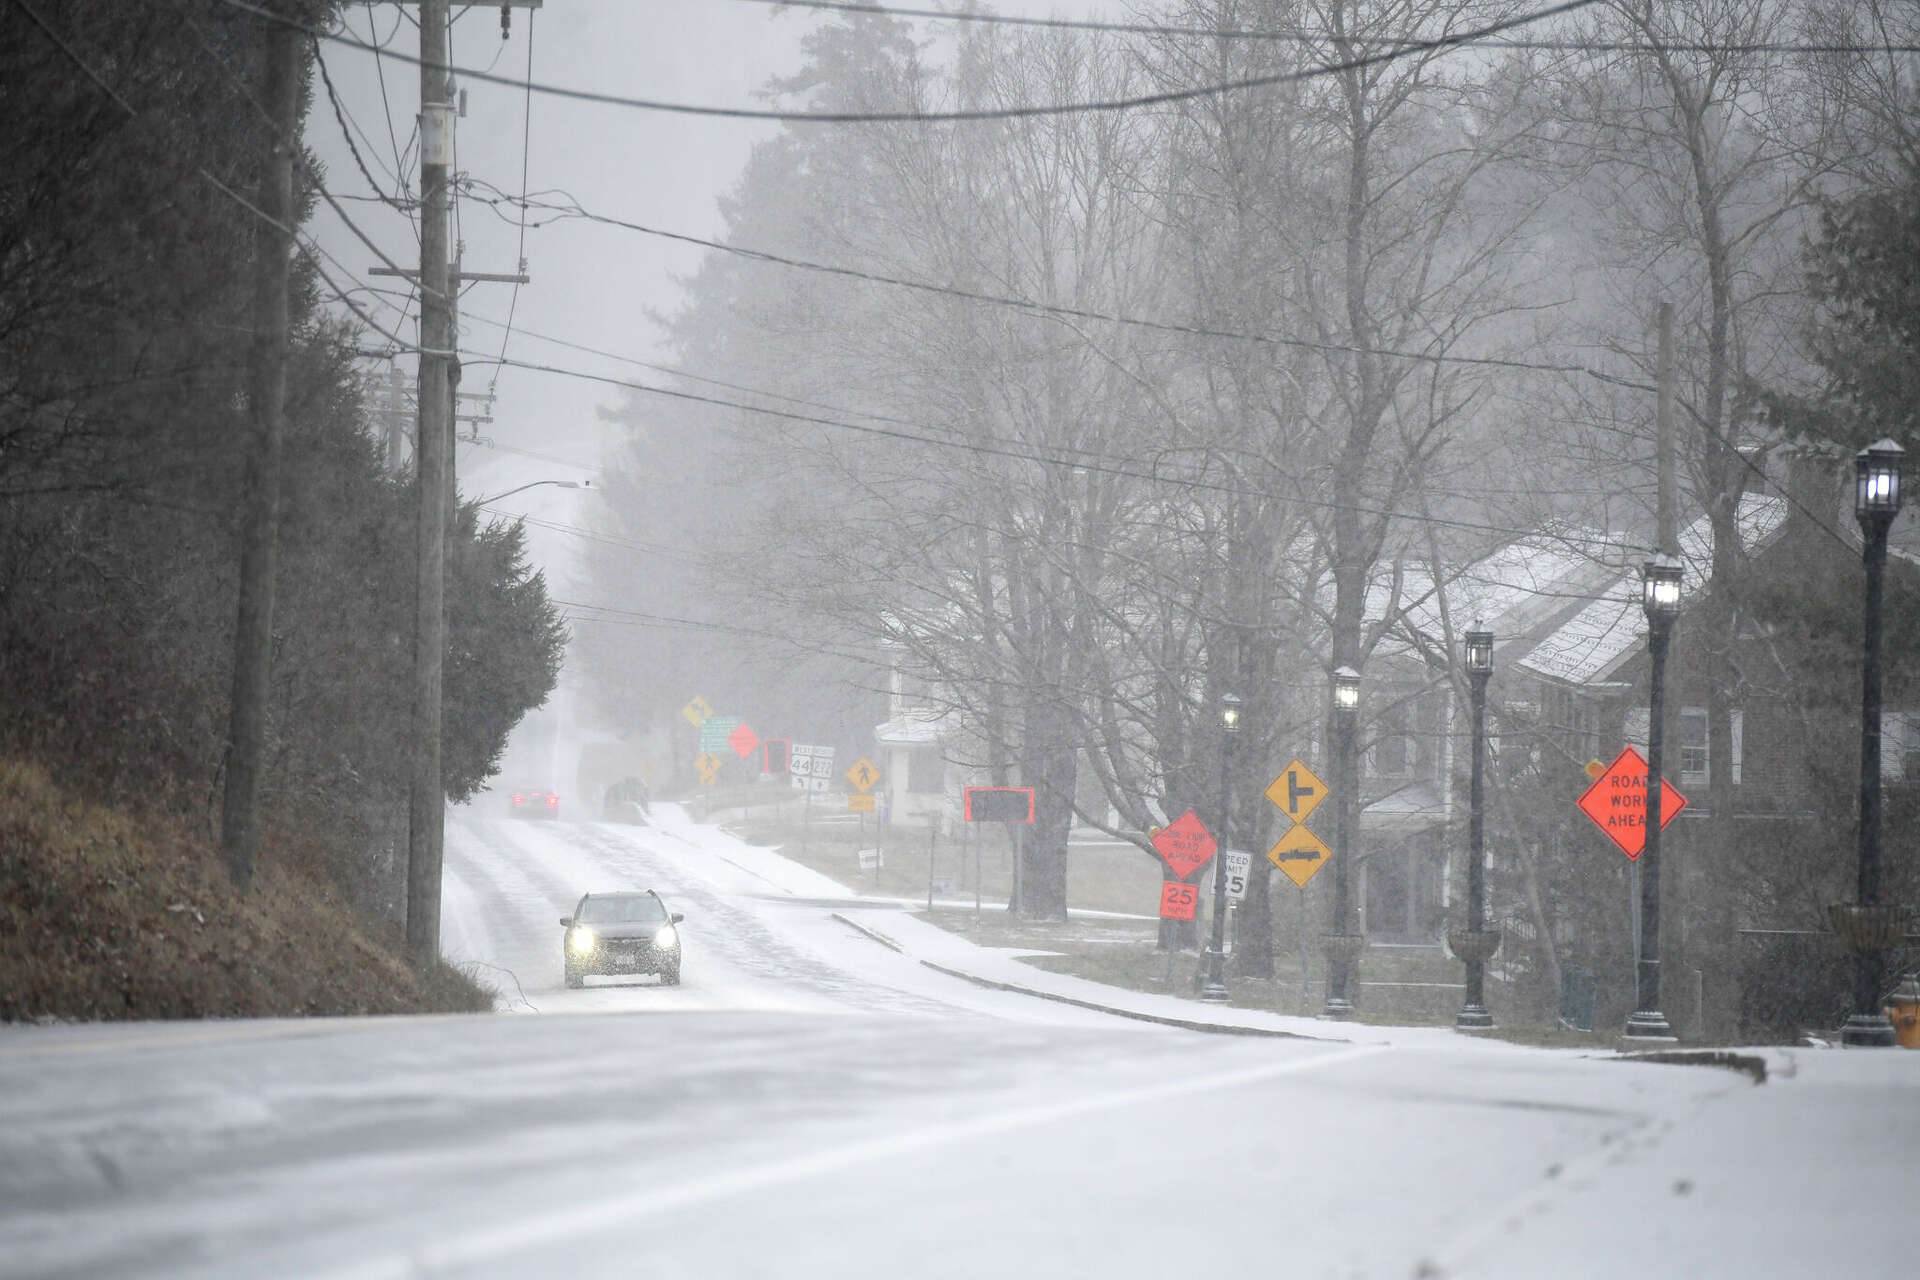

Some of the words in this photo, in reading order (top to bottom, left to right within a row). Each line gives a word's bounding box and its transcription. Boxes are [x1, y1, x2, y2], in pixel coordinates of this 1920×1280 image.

[792, 759, 809, 772] 44
[1608, 814, 1646, 827] AHEA
[1226, 855, 1249, 865] PEED
[1227, 865, 1243, 874] MIT
[1224, 875, 1244, 894] 5
[1167, 887, 1192, 905] 25
